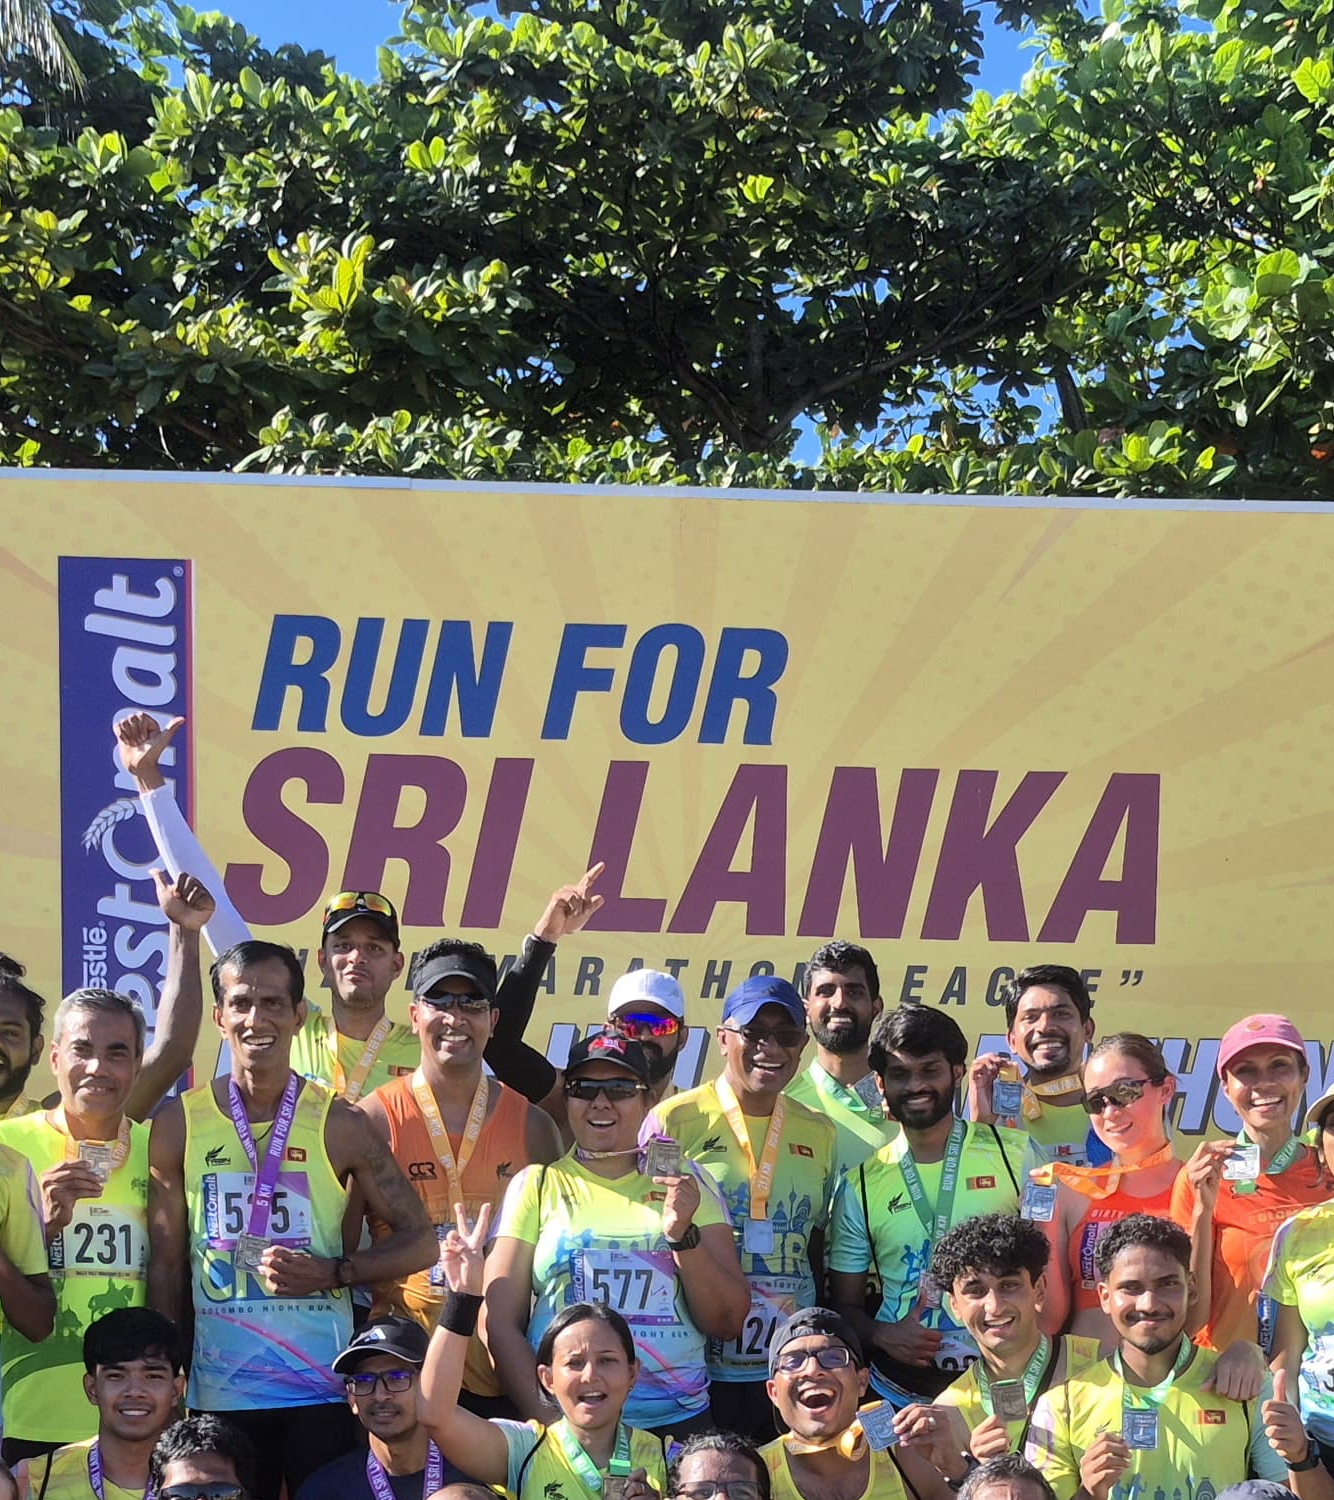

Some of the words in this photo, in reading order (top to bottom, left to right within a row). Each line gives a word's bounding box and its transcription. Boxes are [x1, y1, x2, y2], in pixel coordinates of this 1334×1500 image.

[251, 614, 514, 738] RUN
[541, 623, 789, 746] FOR
[224, 747, 535, 930] SRI
[579, 760, 1160, 945] LANKA
[232, 1105, 244, 1121] SRI
[281, 1103, 294, 1120] SRI
[237, 1121, 250, 1139] FOR
[275, 1121, 288, 1139] FOR
[244, 1139, 256, 1159] RUN
[269, 1140, 283, 1157] RUN
[948, 1144, 959, 1159] SRI
[409, 1162, 436, 1177] CCR
[945, 1159, 956, 1175] FOR
[260, 1184, 273, 1199] KM
[942, 1174, 953, 1192] RUN
[909, 1184, 923, 1201] RUN
[257, 1199, 269, 1207] 5
[225, 1192, 290, 1234] 55
[75, 1222, 133, 1265] 231
[593, 1269, 654, 1310] 577
[308, 1304, 333, 1313] RUN
[735, 1316, 777, 1356] 12
[1024, 1371, 1037, 1391] FOR
[1031, 1358, 1043, 1373] SRI
[428, 1461, 441, 1480] SRI
[373, 1474, 387, 1493] SRI
